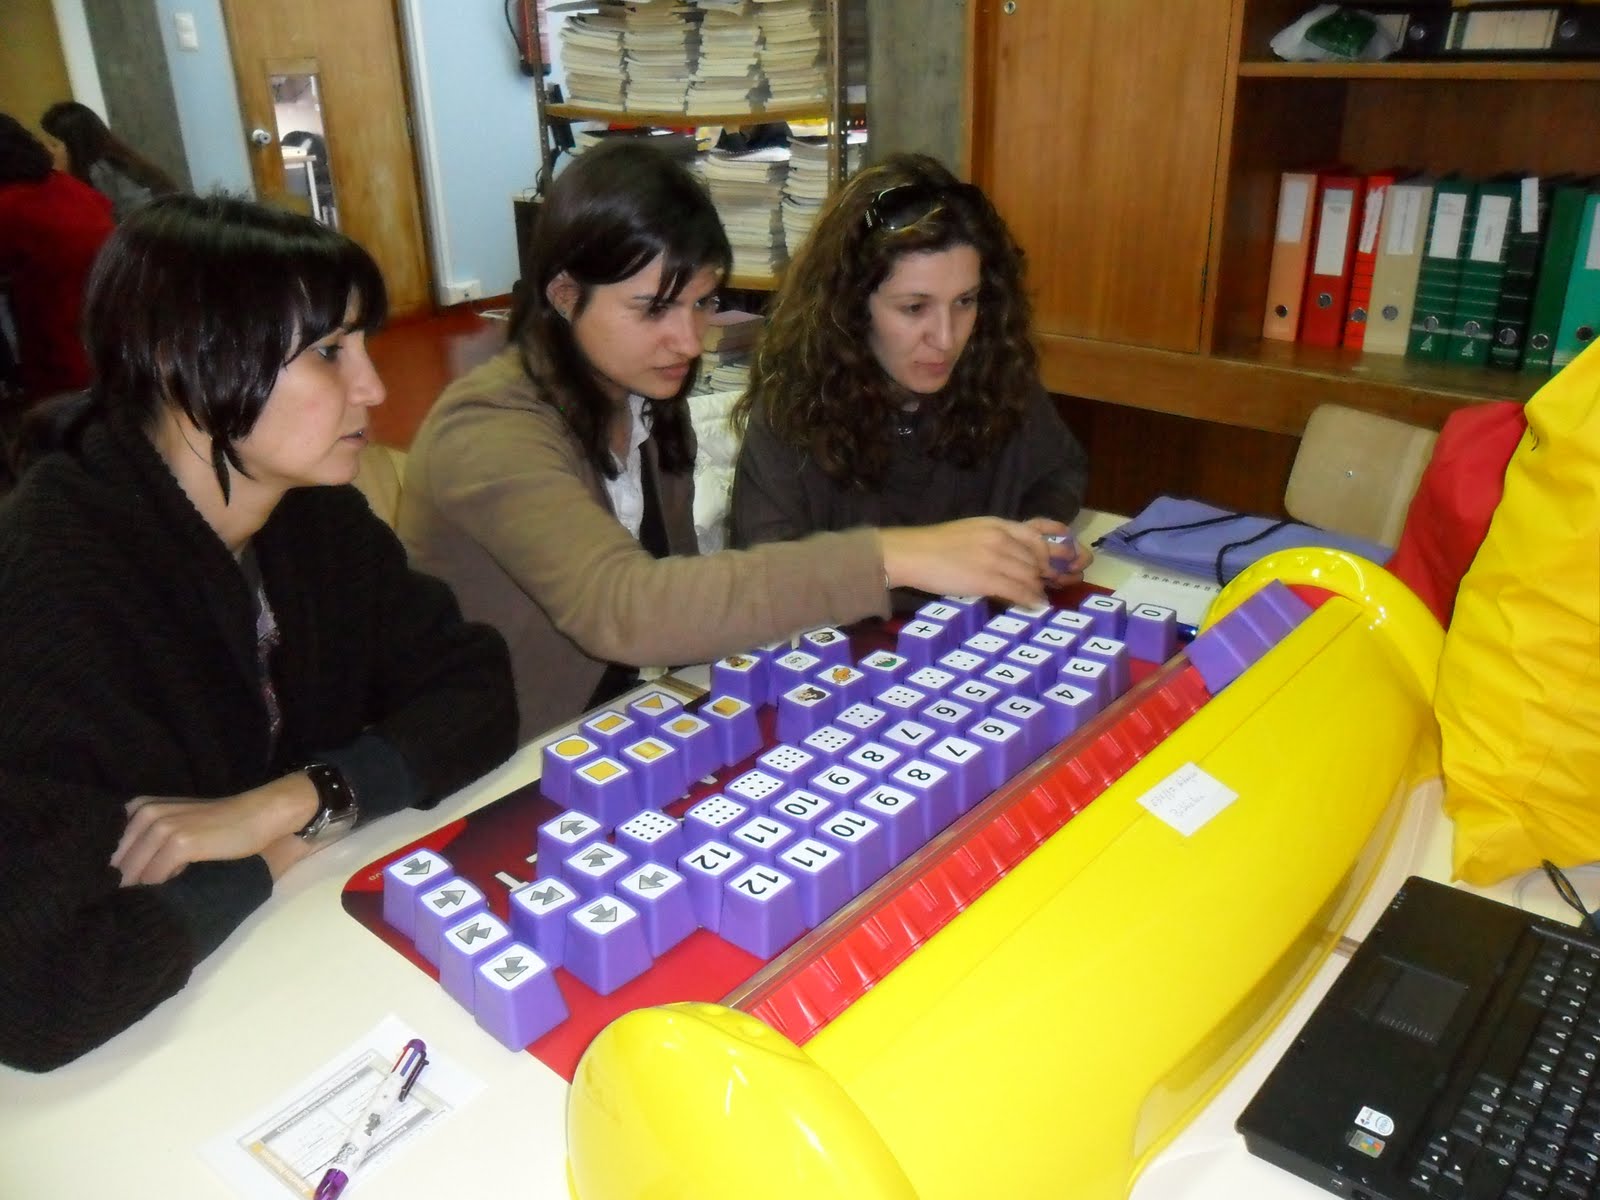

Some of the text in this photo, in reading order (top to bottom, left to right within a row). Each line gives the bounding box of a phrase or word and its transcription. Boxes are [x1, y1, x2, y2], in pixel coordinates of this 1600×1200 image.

[1095, 600, 1114, 608] 0
[1142, 609, 1161, 618] 0
[1041, 632, 1063, 642] 2
[1090, 641, 1112, 651] 2
[1018, 649, 1039, 660] 3
[995, 669, 1015, 680] 4
[1072, 663, 1094, 673] 3
[965, 686, 987, 698] 5
[1055, 689, 1075, 700] 4
[934, 706, 957, 718] 6
[1009, 702, 1032, 714] 5
[901, 728, 922, 741] 7
[982, 725, 1005, 738] 6
[861, 750, 885, 763] 8
[945, 745, 967, 758] 7
[827, 772, 851, 786] 9
[907, 768, 931, 781] 8
[784, 796, 819, 816] 10
[875, 793, 899, 806] 9
[743, 823, 780, 844] 11
[830, 817, 866, 837] 10
[691, 848, 731, 870] 12
[790, 847, 828, 868] 11
[737, 872, 779, 896] 12
